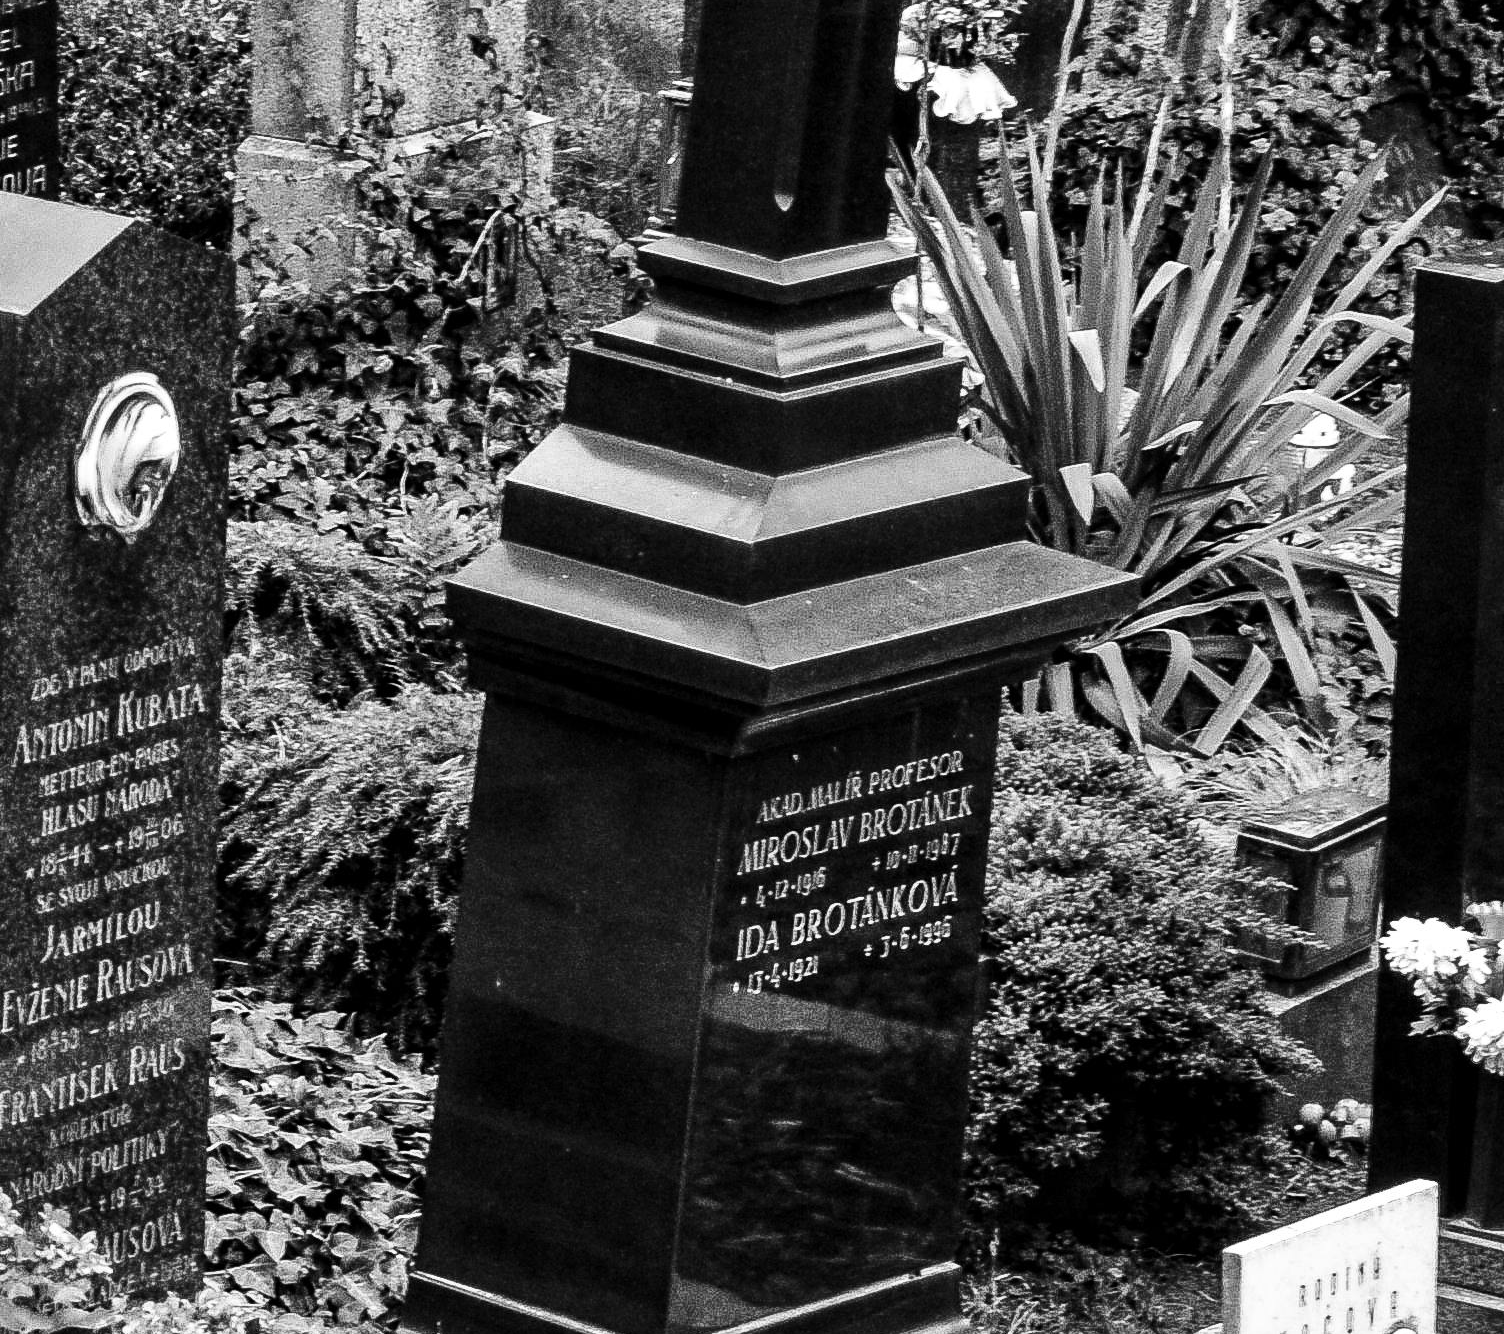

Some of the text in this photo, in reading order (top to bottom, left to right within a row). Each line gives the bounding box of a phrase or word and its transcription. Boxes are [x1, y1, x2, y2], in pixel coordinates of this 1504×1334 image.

[11, 683, 206, 768] ANTONÍN KUBATA
[809, 770, 864, 812] MALÍŘ
[868, 750, 965, 795] PROFESOR
[737, 784, 975, 876] MIROSLAV BROTÁNEK
[40, 900, 162, 964] JARMILOU
[737, 864, 959, 962] IDA BROTÁNKOVÁ
[95, 933, 194, 1003] RAUSOVÁ
[128, 1036, 187, 1087] RAUS
